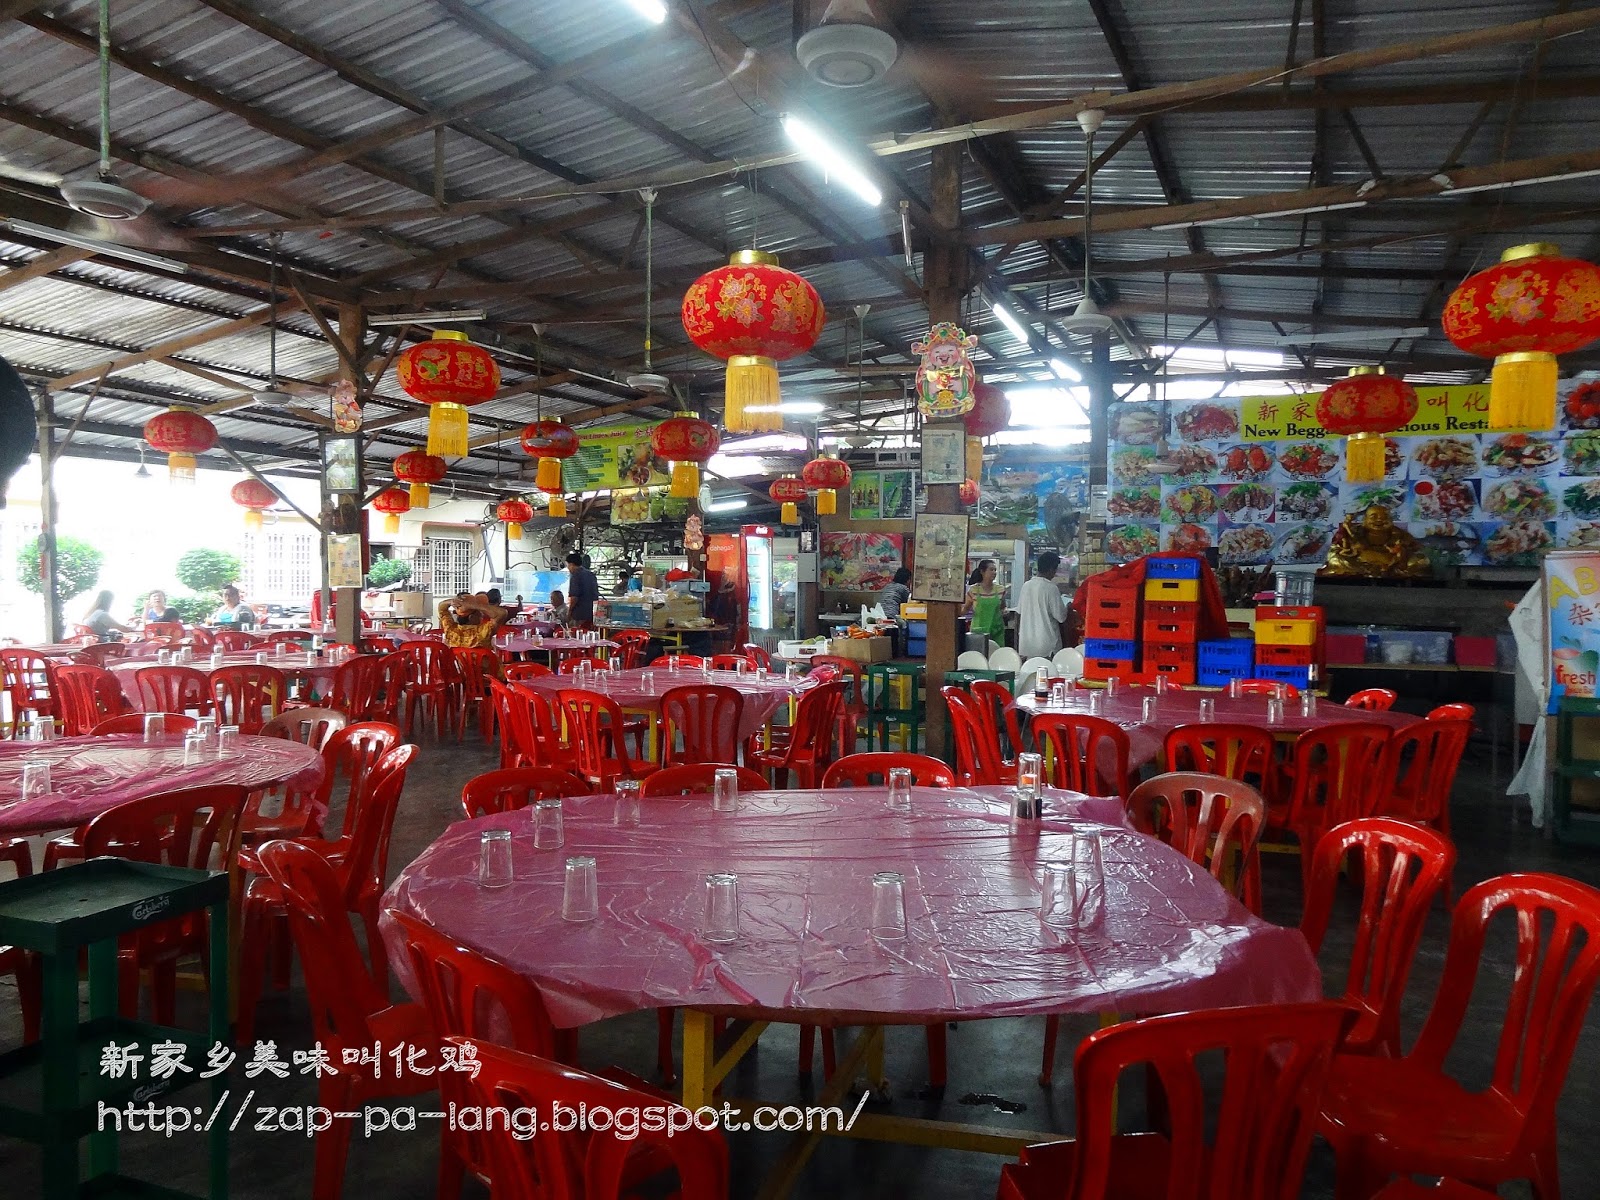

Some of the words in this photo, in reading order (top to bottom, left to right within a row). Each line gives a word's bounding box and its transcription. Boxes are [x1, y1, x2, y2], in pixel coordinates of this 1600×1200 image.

[1245, 424, 1281, 437] New
[1555, 664, 1596, 685] fresh
[132, 896, 170, 920] Carlsberg
